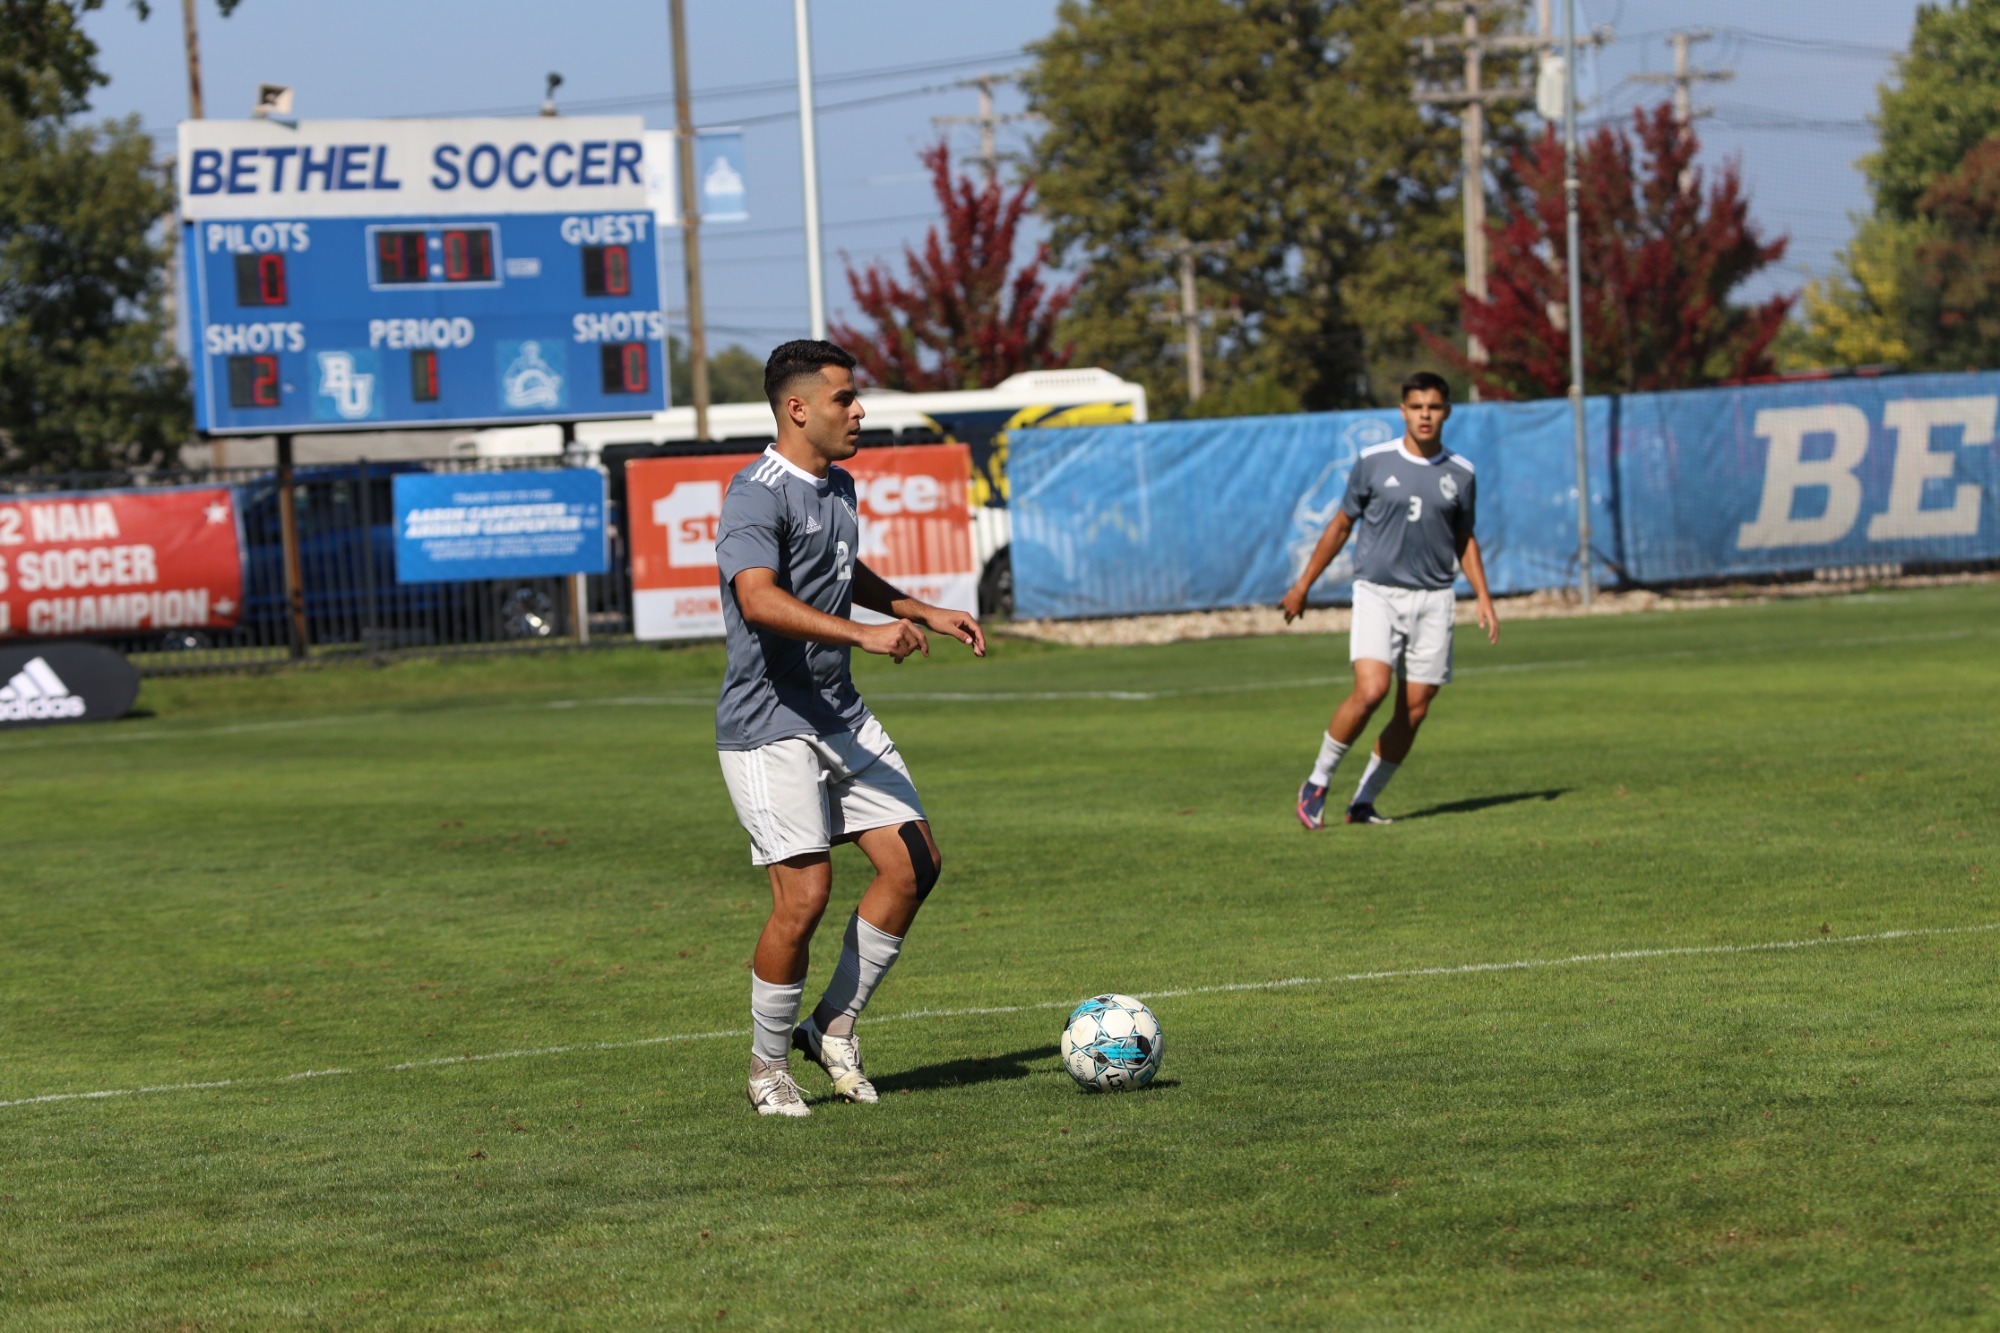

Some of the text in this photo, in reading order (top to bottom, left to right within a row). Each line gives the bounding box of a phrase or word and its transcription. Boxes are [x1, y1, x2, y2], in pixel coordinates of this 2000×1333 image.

[188, 140, 644, 196] BETHEL SOCCER
[206, 223, 311, 253] PILOTS
[560, 214, 650, 245] GUEST
[258, 253, 287, 305] 0
[604, 246, 629, 296] 0
[205, 322, 306, 355] SHOTS
[368, 318, 475, 349] PERIOD
[572, 310, 665, 342] SHOTS
[253, 355, 278, 406] 2
[623, 341, 648, 393] 0
[1736, 396, 1999, 550] BE
[30, 502, 120, 543] NAIA
[1407, 495, 1423, 522] 3
[16, 544, 159, 592] SOCCER
[834, 541, 852, 581] 2
[27, 587, 210, 635] CHAMPION
[0, 694, 87, 721] didas
